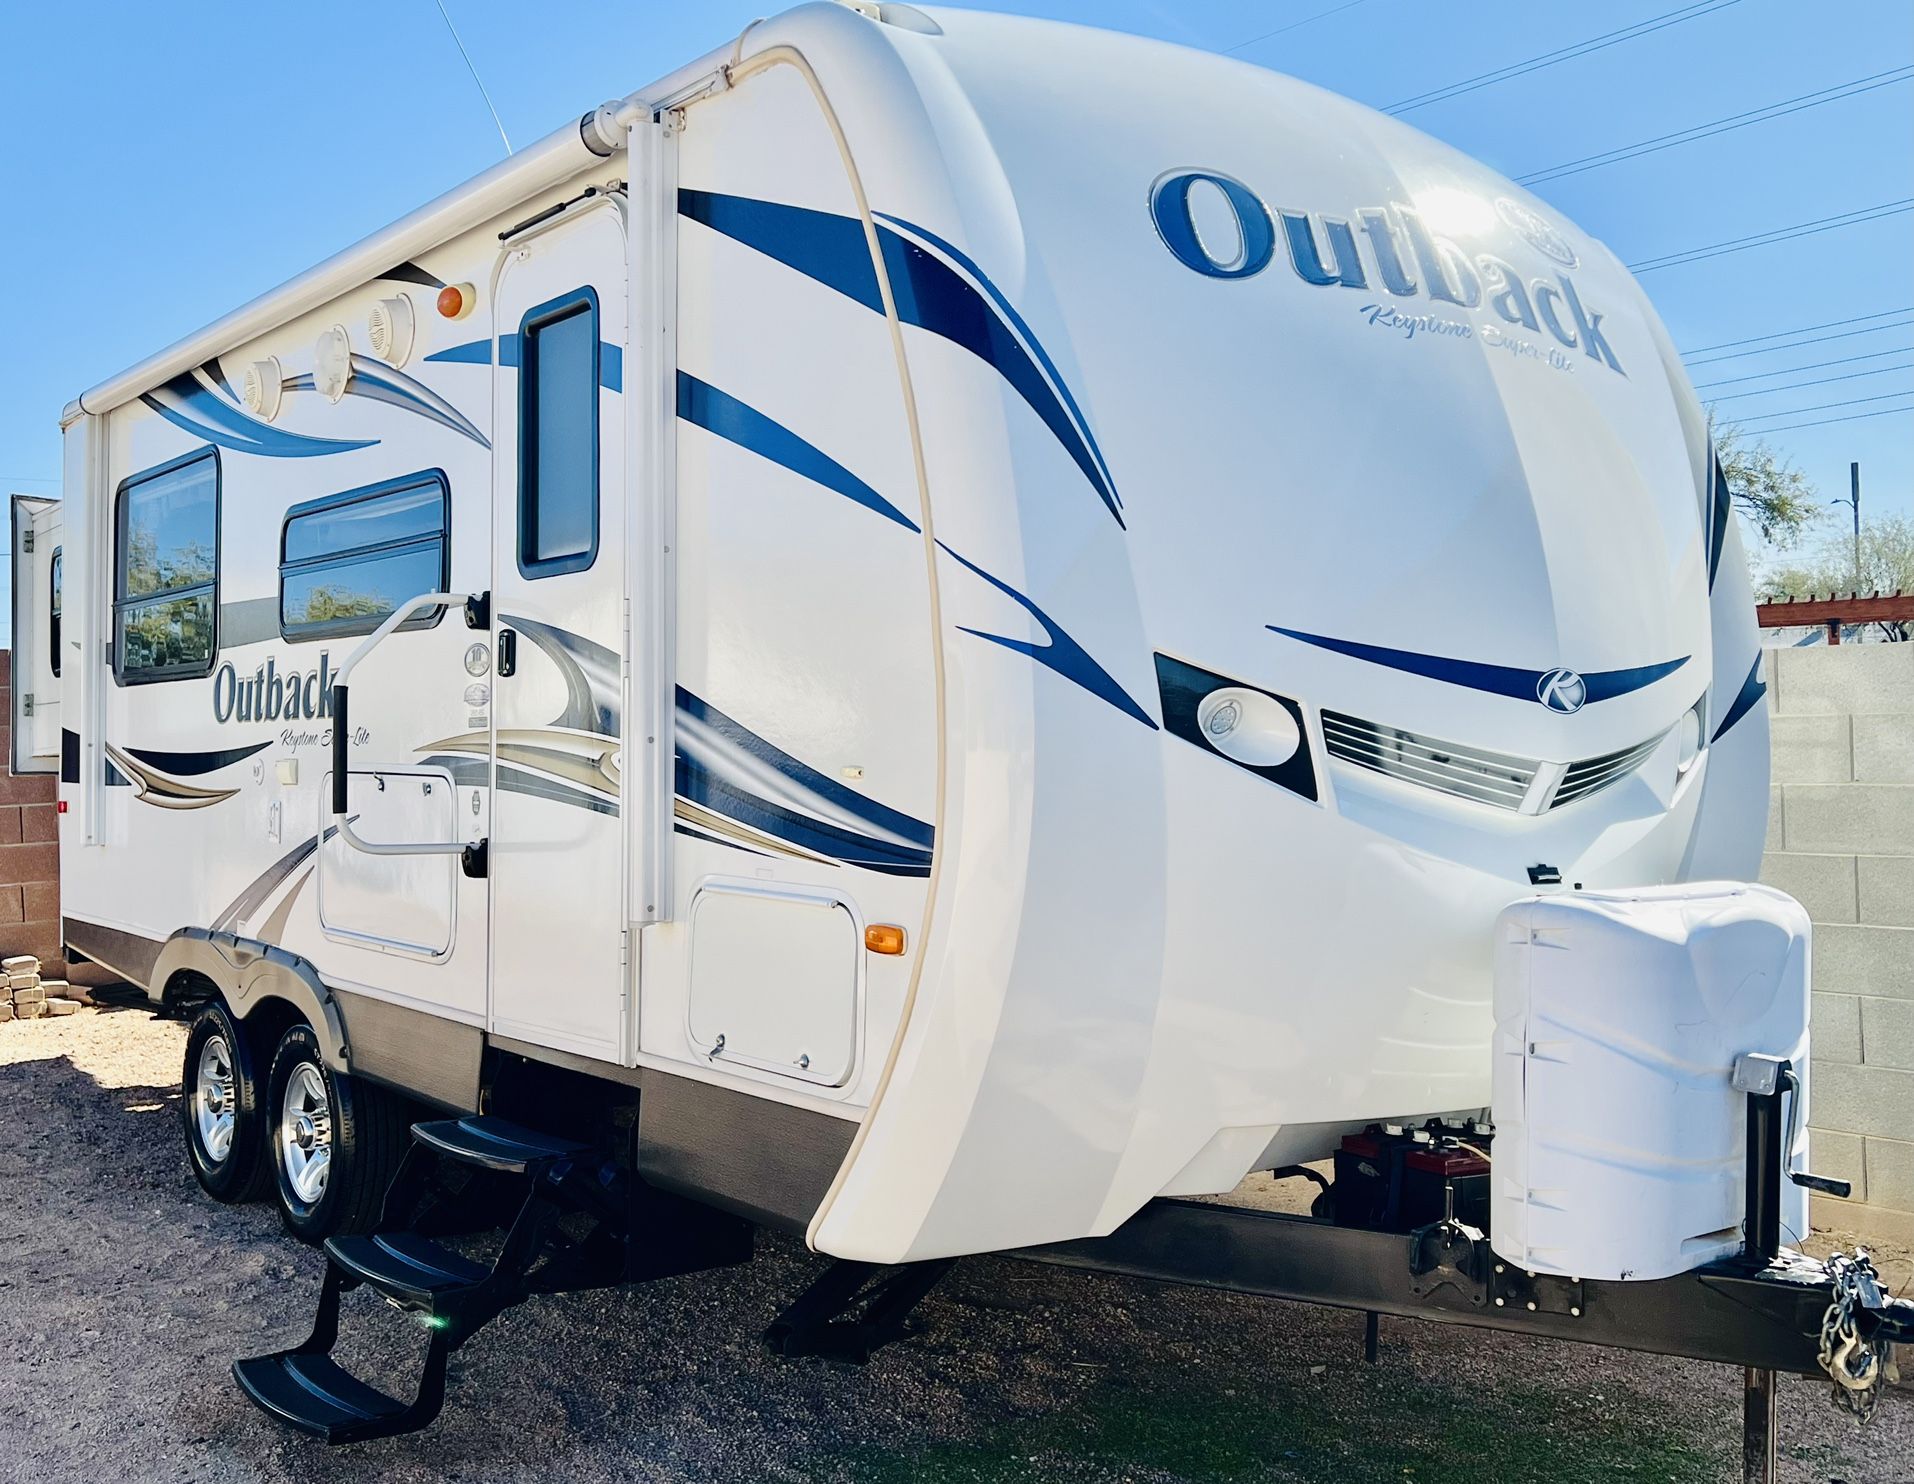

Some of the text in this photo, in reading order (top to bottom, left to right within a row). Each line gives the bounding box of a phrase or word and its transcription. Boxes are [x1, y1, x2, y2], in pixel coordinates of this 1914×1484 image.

[1147, 166, 1630, 380] Outback
[1360, 303, 1473, 339] Keystone
[213, 649, 340, 725] Outback
[280, 727, 370, 754] Keystone S-Lite
